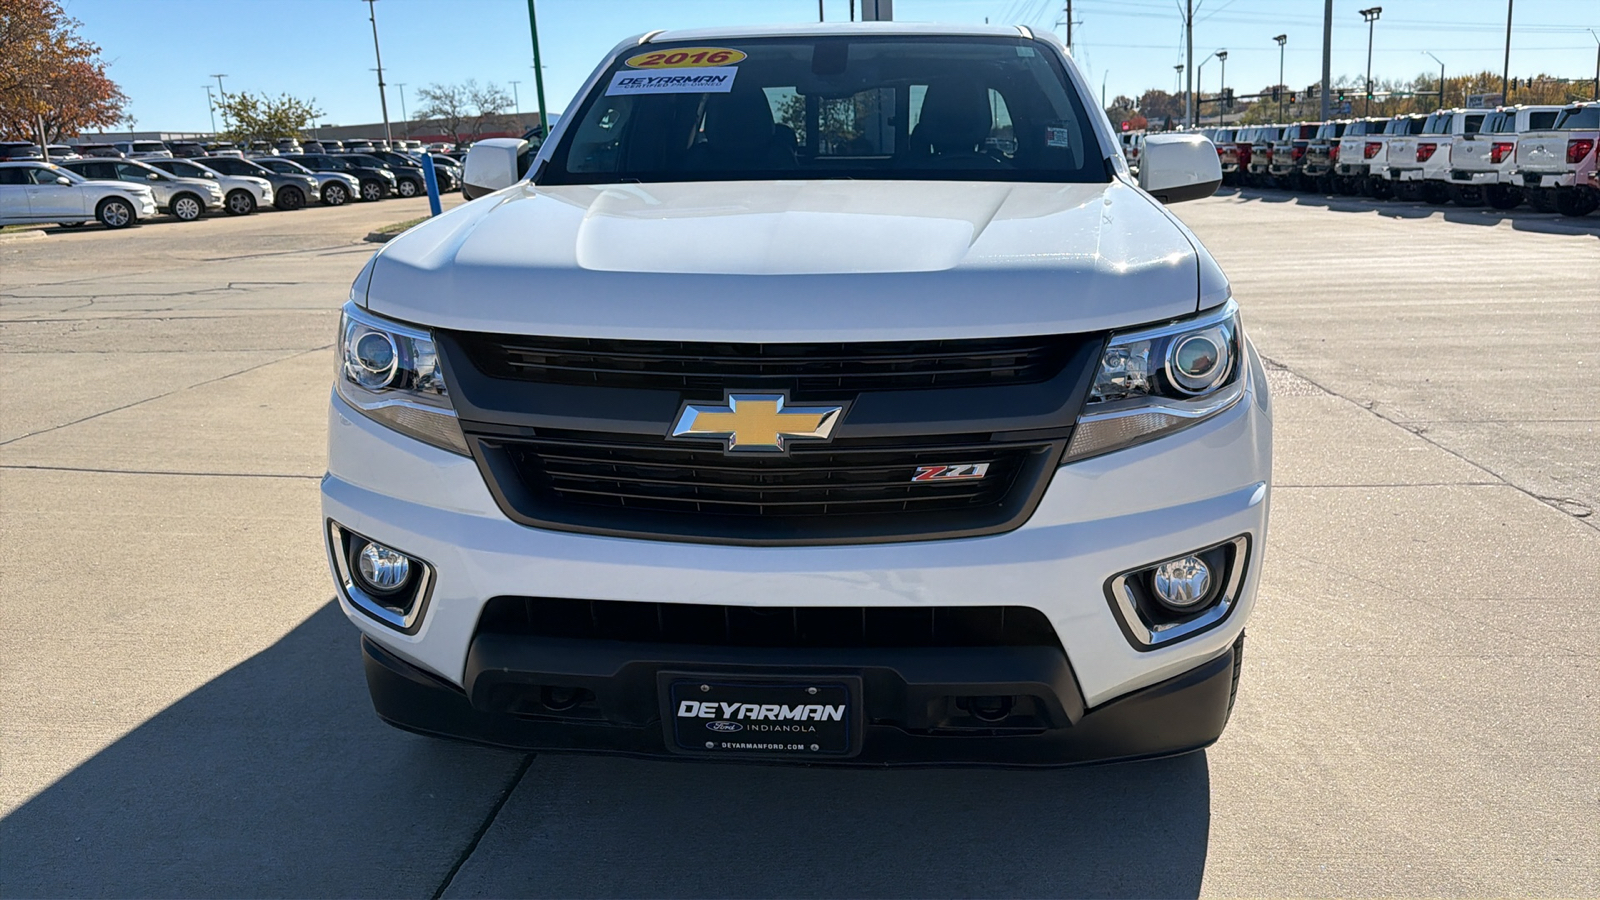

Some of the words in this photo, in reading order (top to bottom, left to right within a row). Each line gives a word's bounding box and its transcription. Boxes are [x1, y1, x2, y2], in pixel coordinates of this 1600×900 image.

[638, 51, 733, 66] 2016
[618, 75, 728, 86] DEYARMAN
[911, 463, 990, 481] Z71
[677, 700, 846, 721] DEYARMAN
[713, 722, 736, 731] Ford
[746, 724, 816, 732] INDIANOLA
[721, 742, 805, 750] DEYARMANFORD.COM
